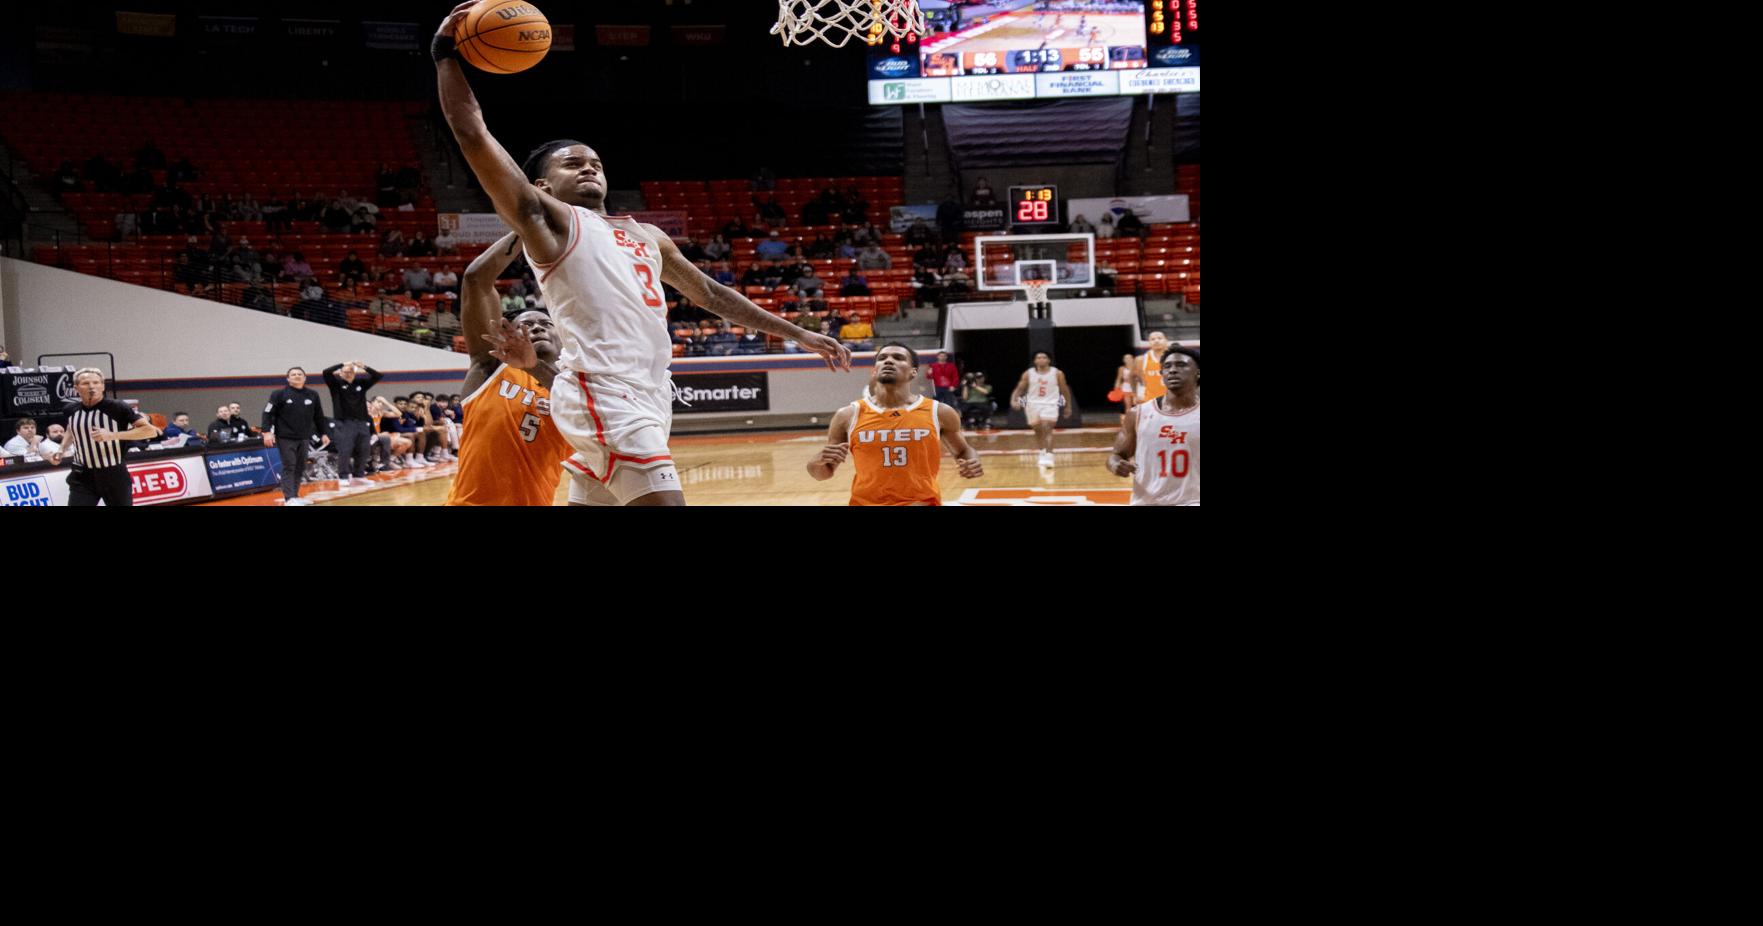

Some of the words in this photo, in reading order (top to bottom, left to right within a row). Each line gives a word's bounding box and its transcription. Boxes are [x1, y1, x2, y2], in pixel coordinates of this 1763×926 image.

[1189, 10, 1197, 19] 5
[1150, 22, 1165, 33] 13
[1173, 21, 1181, 31] 3
[1190, 21, 1198, 30] 9
[519, 30, 550, 41] NCAA
[907, 32, 916, 43] 6
[1173, 32, 1182, 42] 5
[1022, 48, 1060, 63] 1:13
[1079, 48, 1103, 62] 55
[1026, 189, 1052, 201] 1:13
[964, 209, 1004, 220] aspen
[1018, 201, 1048, 220] 28
[633, 263, 662, 307] 3
[13, 375, 49, 386] JOHNSON
[13, 394, 50, 406] COLISEUM
[671, 386, 765, 401] etSmarter
[520, 413, 541, 442] 5
[859, 429, 930, 443] UTEP
[241, 456, 263, 465] Optimum
[881, 446, 907, 468] 13
[1157, 450, 1189, 477] 10
[6, 482, 40, 501] BUD
